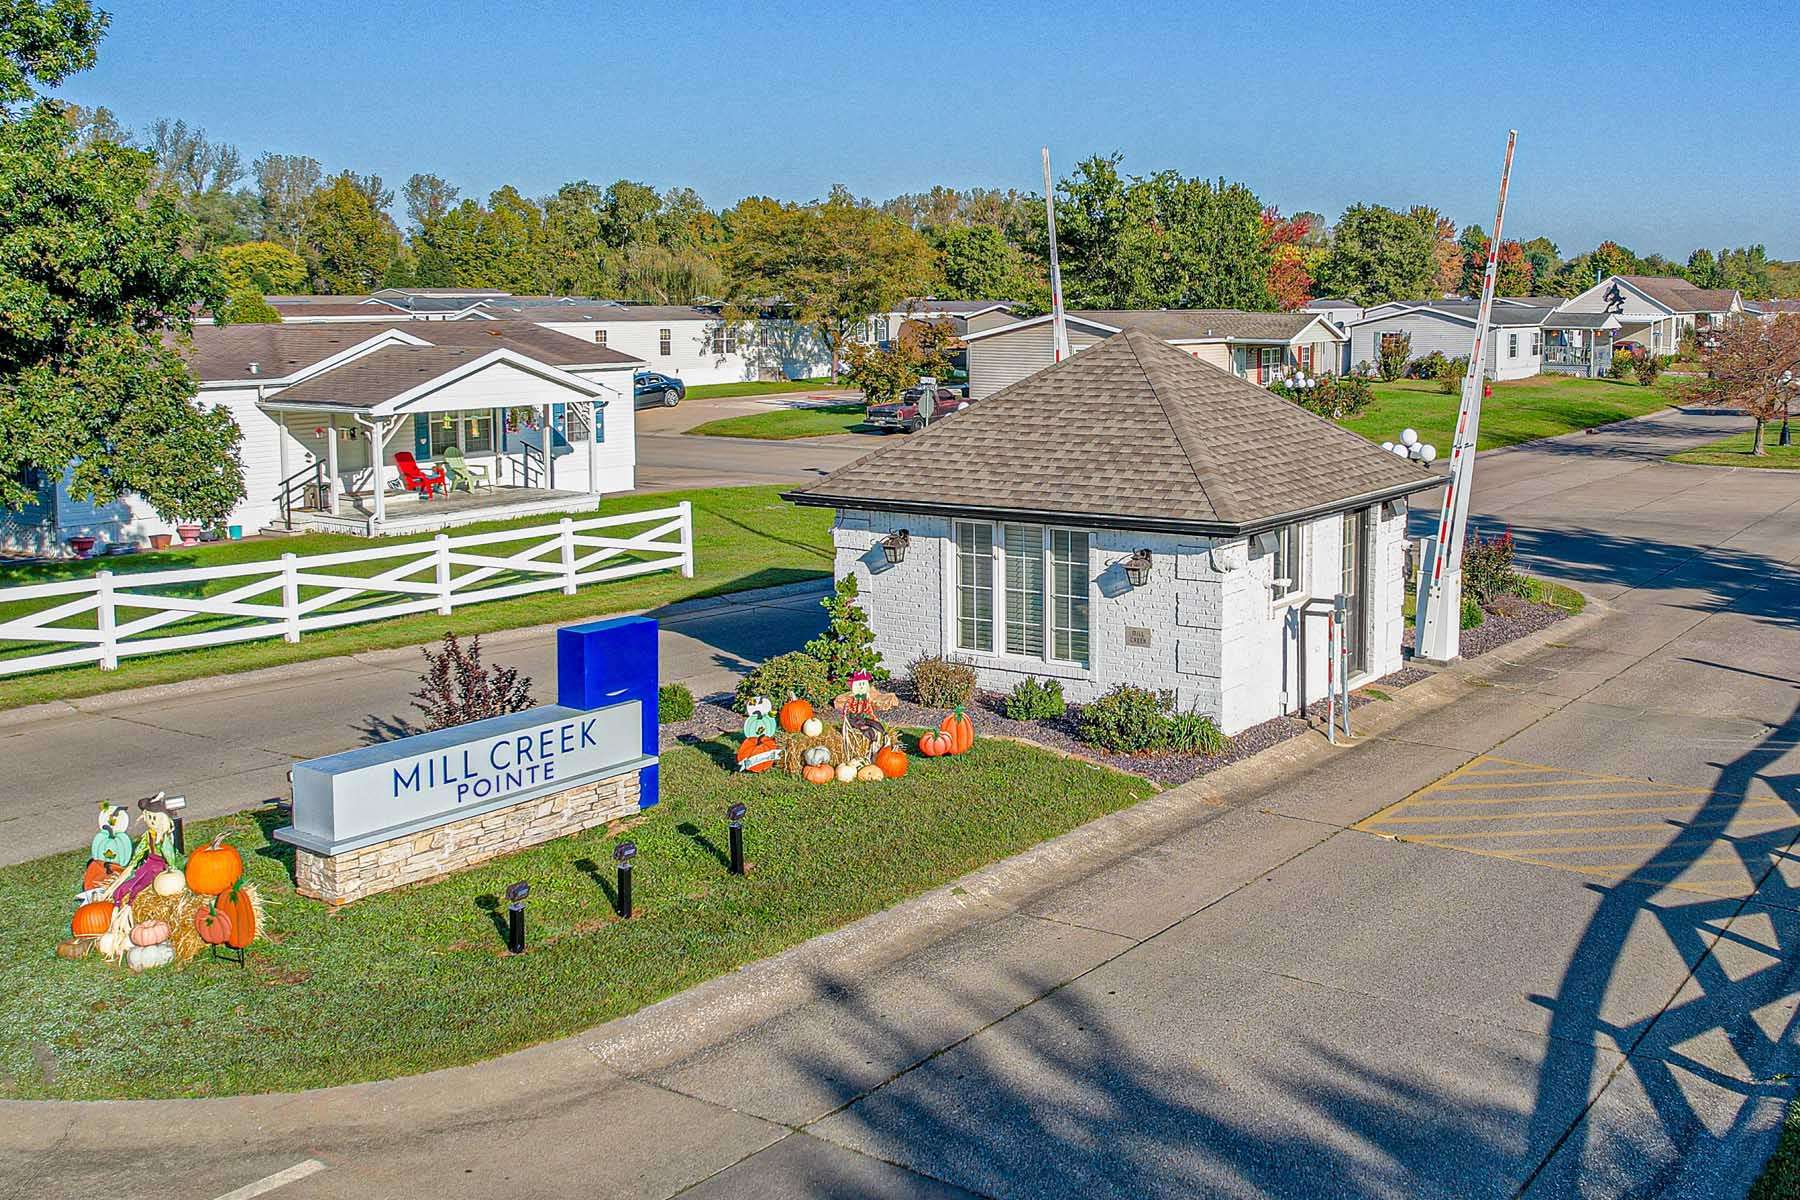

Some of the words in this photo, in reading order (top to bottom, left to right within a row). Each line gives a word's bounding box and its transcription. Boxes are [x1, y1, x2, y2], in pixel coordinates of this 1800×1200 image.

[393, 750, 478, 798] MILL
[490, 718, 597, 770] CREEK
[457, 761, 554, 803] POINTE
